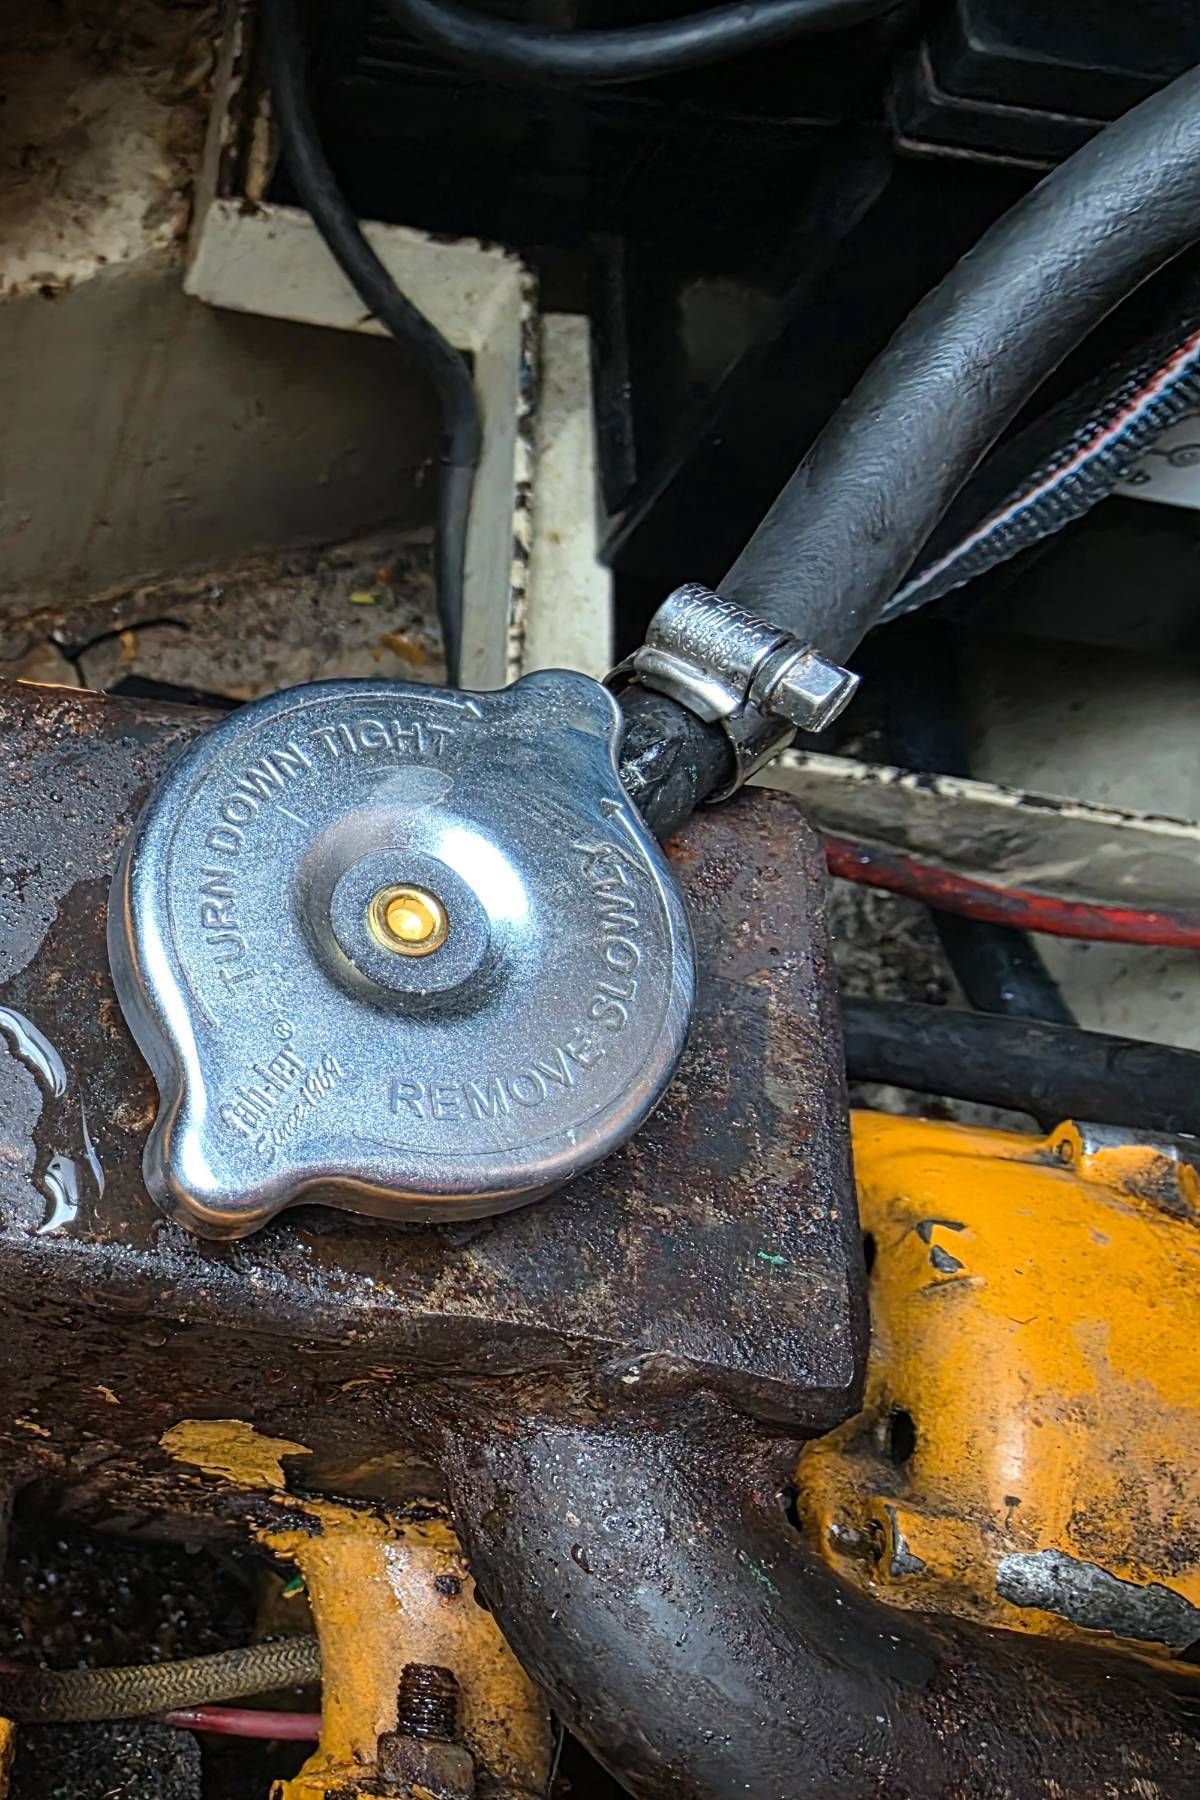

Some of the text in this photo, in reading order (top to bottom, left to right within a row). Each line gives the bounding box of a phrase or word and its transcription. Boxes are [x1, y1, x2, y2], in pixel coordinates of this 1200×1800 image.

[673, 595, 763, 648] STAINLESS
[199, 719, 455, 997] TURN DOWN TIGHT
[300, 1053, 344, 1107] 1969
[389, 1026, 606, 1121] REMOVE
